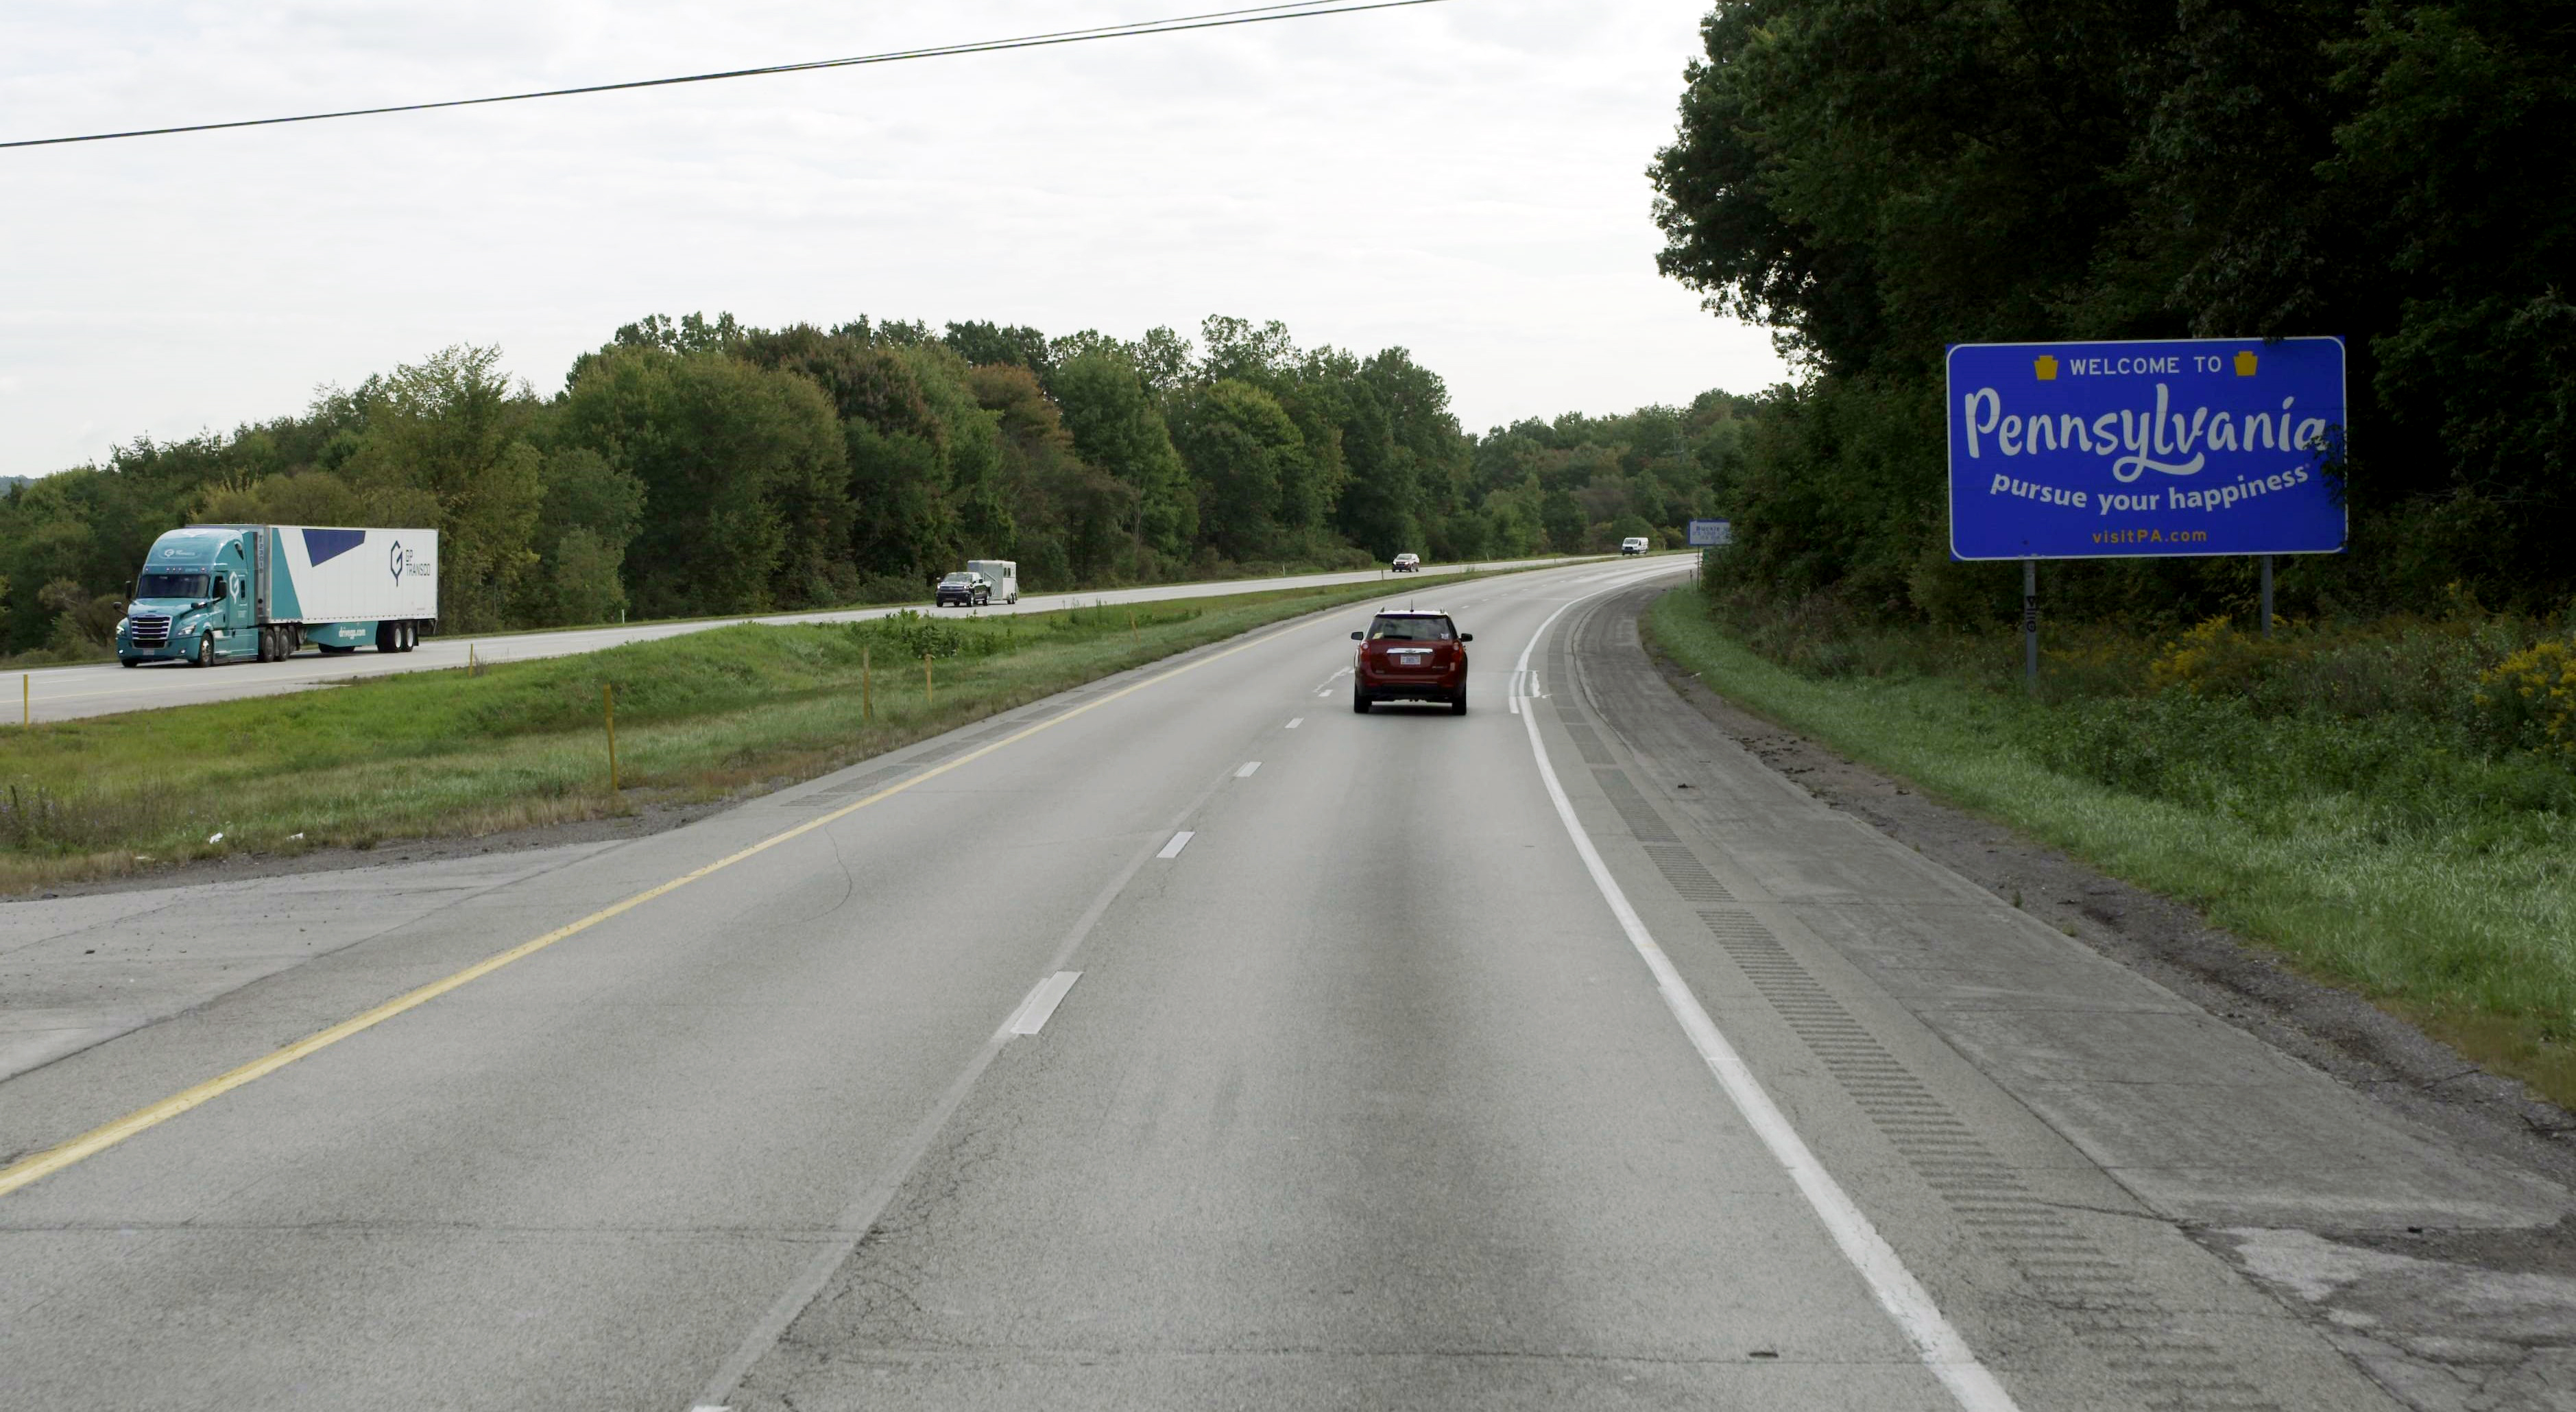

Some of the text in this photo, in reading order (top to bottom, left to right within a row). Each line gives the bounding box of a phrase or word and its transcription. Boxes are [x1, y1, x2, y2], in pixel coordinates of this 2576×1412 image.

[2069, 356, 2222, 376] WELCOME TO
[1964, 383, 2329, 483] Pennsylvania
[1990, 466, 2309, 515] pursue your happiness
[2092, 528, 2207, 544] visitPA.com
[405, 549, 413, 562] GP
[405, 563, 431, 577] TRANSCO
